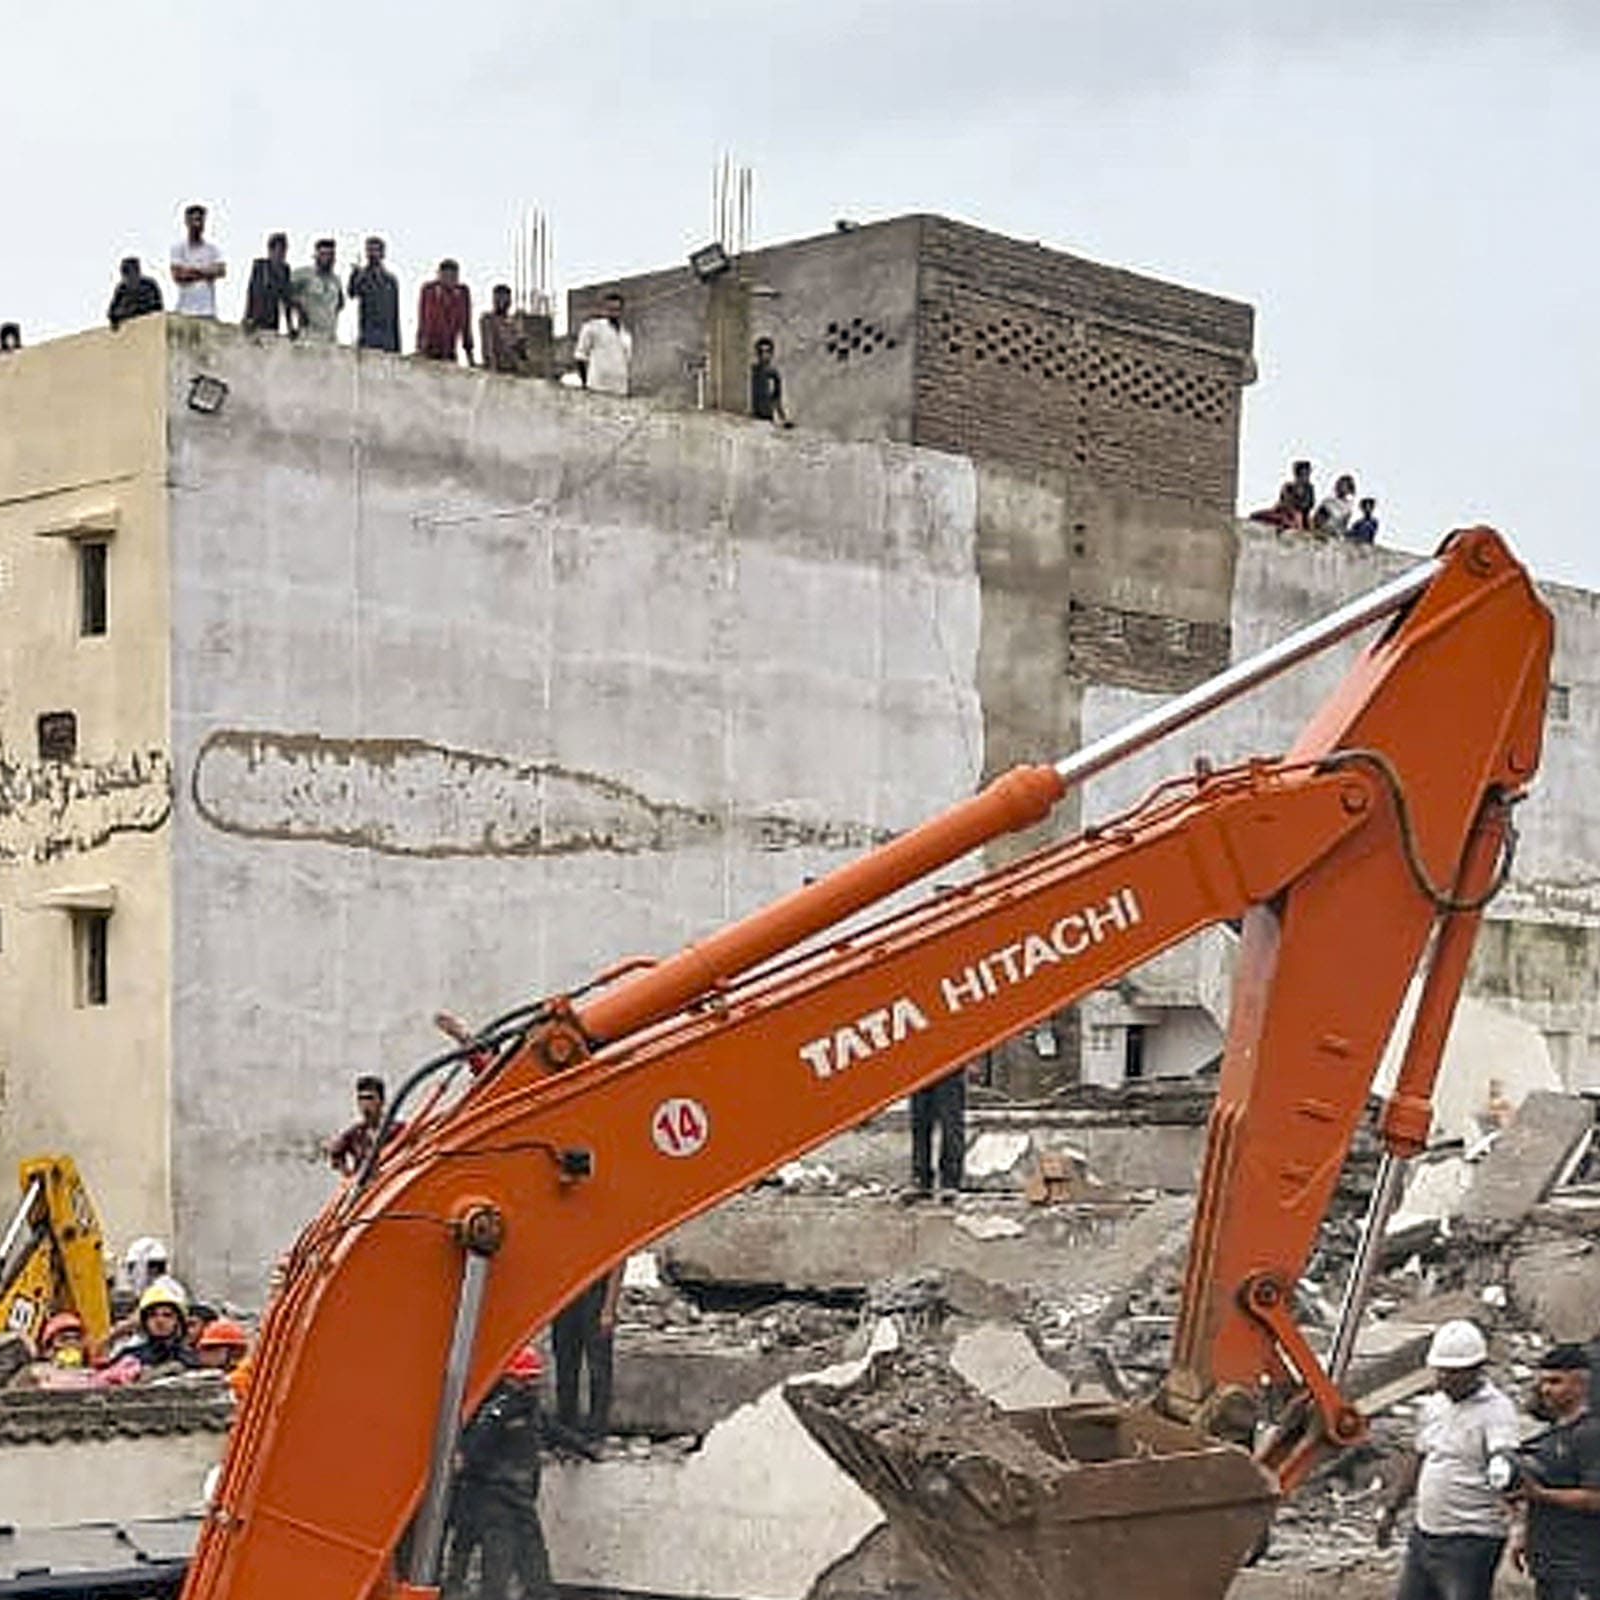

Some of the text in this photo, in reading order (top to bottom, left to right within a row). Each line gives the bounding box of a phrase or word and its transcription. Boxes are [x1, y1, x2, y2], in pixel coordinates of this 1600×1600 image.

[800, 887, 1141, 1079] TATA HITACHI
[657, 1104, 701, 1150] 14
